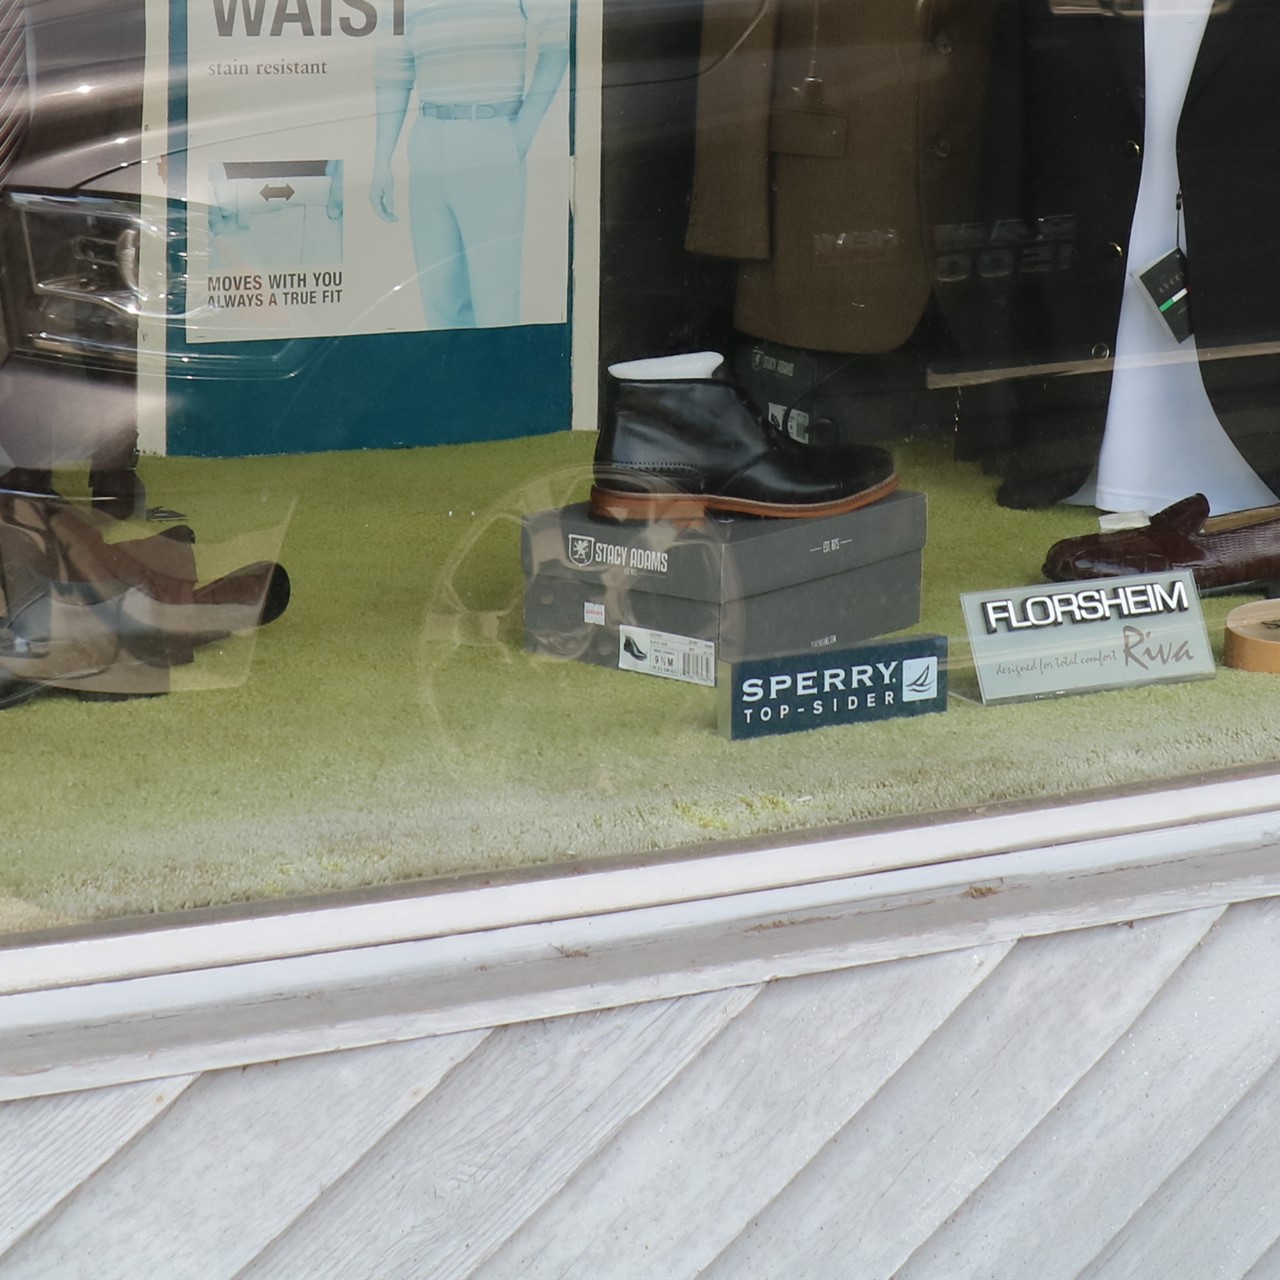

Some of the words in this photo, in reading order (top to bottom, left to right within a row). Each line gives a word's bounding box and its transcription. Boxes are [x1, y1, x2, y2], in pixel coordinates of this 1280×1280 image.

[208, 59, 249, 76] stain
[256, 59, 328, 76] resistant
[207, 274, 263, 292] MOVES
[268, 272, 307, 290] WITH
[311, 271, 343, 288] YOU
[206, 292, 263, 310] ALWAYS
[267, 291, 279, 307] A
[282, 290, 318, 306] TRUE
[321, 288, 343, 305] FIT
[595, 542, 628, 566] STACY
[630, 548, 668, 573] ADAMS
[981, 580, 1189, 634] FLORSHEIM
[996, 658, 1037, 677] designed
[1039, 658, 1053, 674] for
[1055, 654, 1078, 669] total
[1081, 650, 1117, 667] comfort
[1122, 625, 1194, 670] Riva
[742, 661, 898, 702] SPERRY
[744, 691, 894, 724] TOP-SIDER
